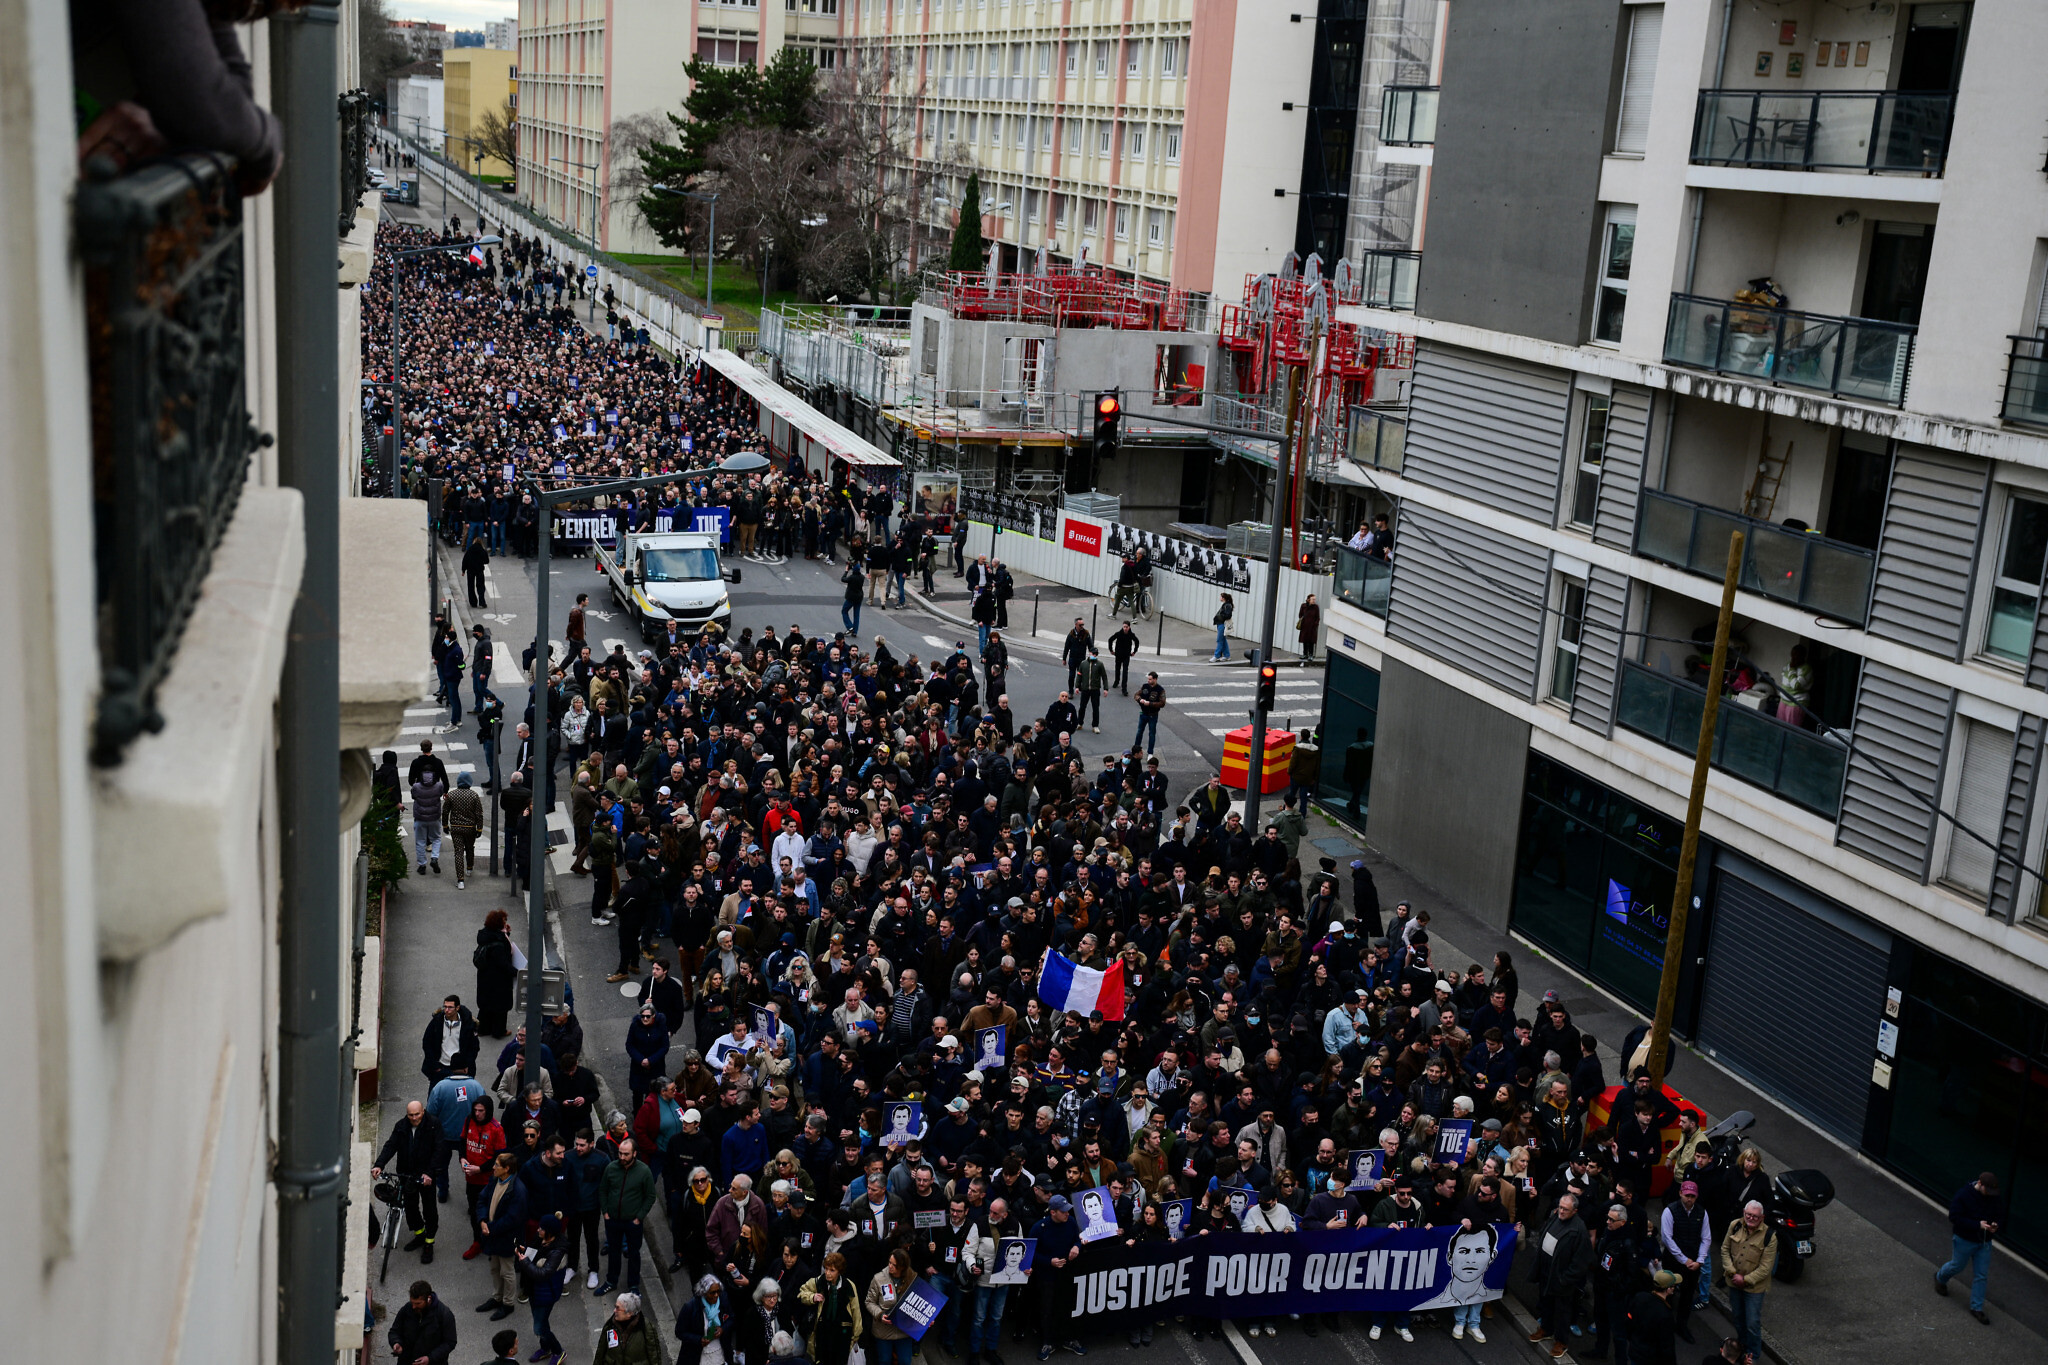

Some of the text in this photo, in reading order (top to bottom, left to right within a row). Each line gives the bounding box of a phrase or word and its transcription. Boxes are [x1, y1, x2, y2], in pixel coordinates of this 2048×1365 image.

[681, 438, 691, 450] TUE
[696, 514, 722, 535] TUE
[1075, 533, 1097, 546] EIFFAGE
[1888, 1002, 1898, 1014] 20
[1439, 1132, 1466, 1153] TUE
[1085, 1223, 1112, 1237] QUENTIN
[1071, 1247, 1439, 1318] JUSTICE POUR QUENTIN
[898, 1301, 930, 1327] ASSASSINS
[904, 1291, 937, 1318] ANTIFAS
